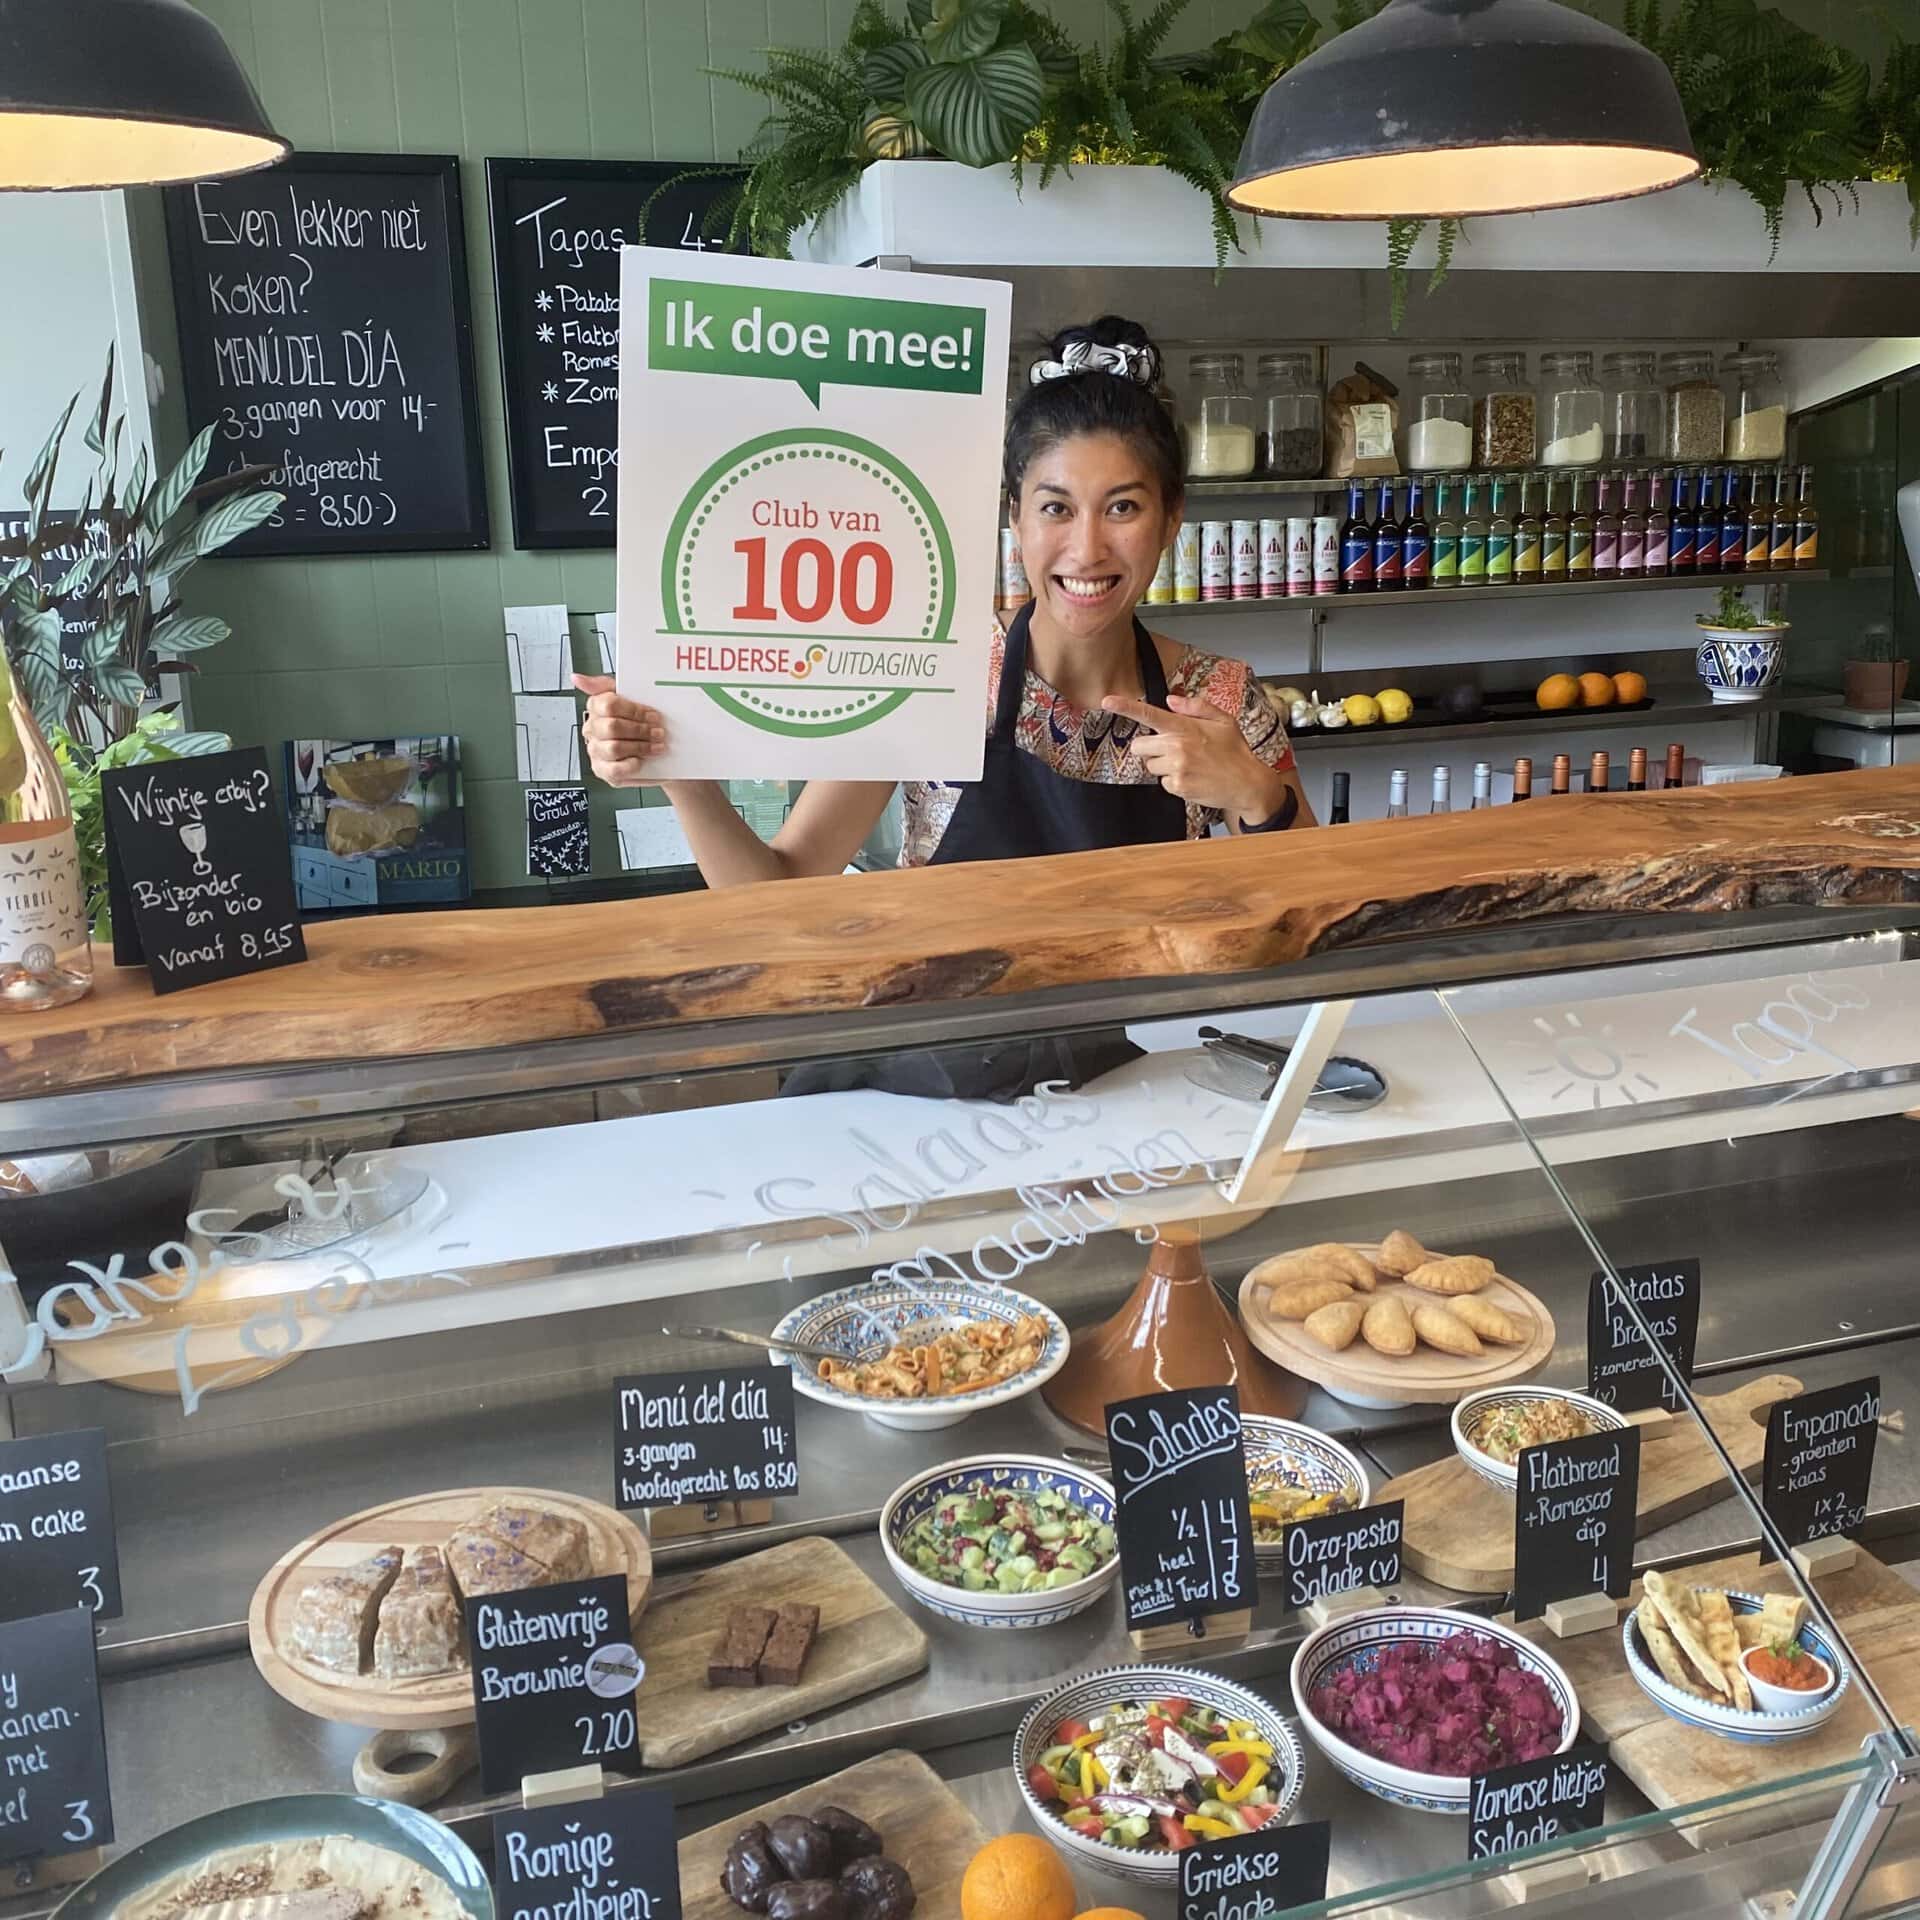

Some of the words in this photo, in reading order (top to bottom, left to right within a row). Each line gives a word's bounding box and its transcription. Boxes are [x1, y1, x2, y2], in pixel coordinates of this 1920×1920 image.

[195, 182, 281, 248] Even
[290, 185, 373, 248] lekker
[381, 200, 427, 250] niet
[515, 196, 626, 269] Tapas
[289, 333, 336, 387] DEL
[341, 319, 406, 389] DÍA
[664, 301, 715, 352] Ik
[730, 307, 830, 360] doe
[847, 326, 973, 372] mee!
[332, 399, 386, 421] voor
[752, 500, 819, 530] Club
[829, 506, 881, 532] van
[732, 536, 893, 626] 100
[676, 645, 789, 674] HELDERSE
[826, 650, 938, 678] UITDAGING
[379, 859, 462, 881] MARIO
[133, 874, 242, 912] Bijzonder
[225, 893, 262, 915] bio
[620, 1384, 689, 1431] Menú
[693, 1380, 725, 1423] del
[731, 1379, 769, 1420] día
[1110, 1397, 1241, 1482] Salades
[622, 1468, 729, 1505] hoofdgerecht
[733, 1465, 760, 1490] los
[1528, 1443, 1620, 1492] Flatbread
[31, 1509, 87, 1539] cake
[1220, 1497, 1237, 1535] 4
[1576, 1517, 1606, 1547] dip
[1158, 1546, 1195, 1573] heel
[1593, 1555, 1607, 1591] 4
[77, 1566, 104, 1612] 3
[1222, 1571, 1241, 1598] 8
[1291, 1562, 1363, 1605] Salade
[477, 1597, 609, 1648] Glutenvrije
[481, 1655, 586, 1702] Brownie
[6, 1744, 49, 1776] met
[1473, 1777, 1548, 1823] Zomerse
[1552, 1760, 1607, 1808] bietjes
[62, 1800, 94, 1842] 3
[505, 1822, 614, 1888] Romige
[1184, 1851, 1280, 1897] Griekse
